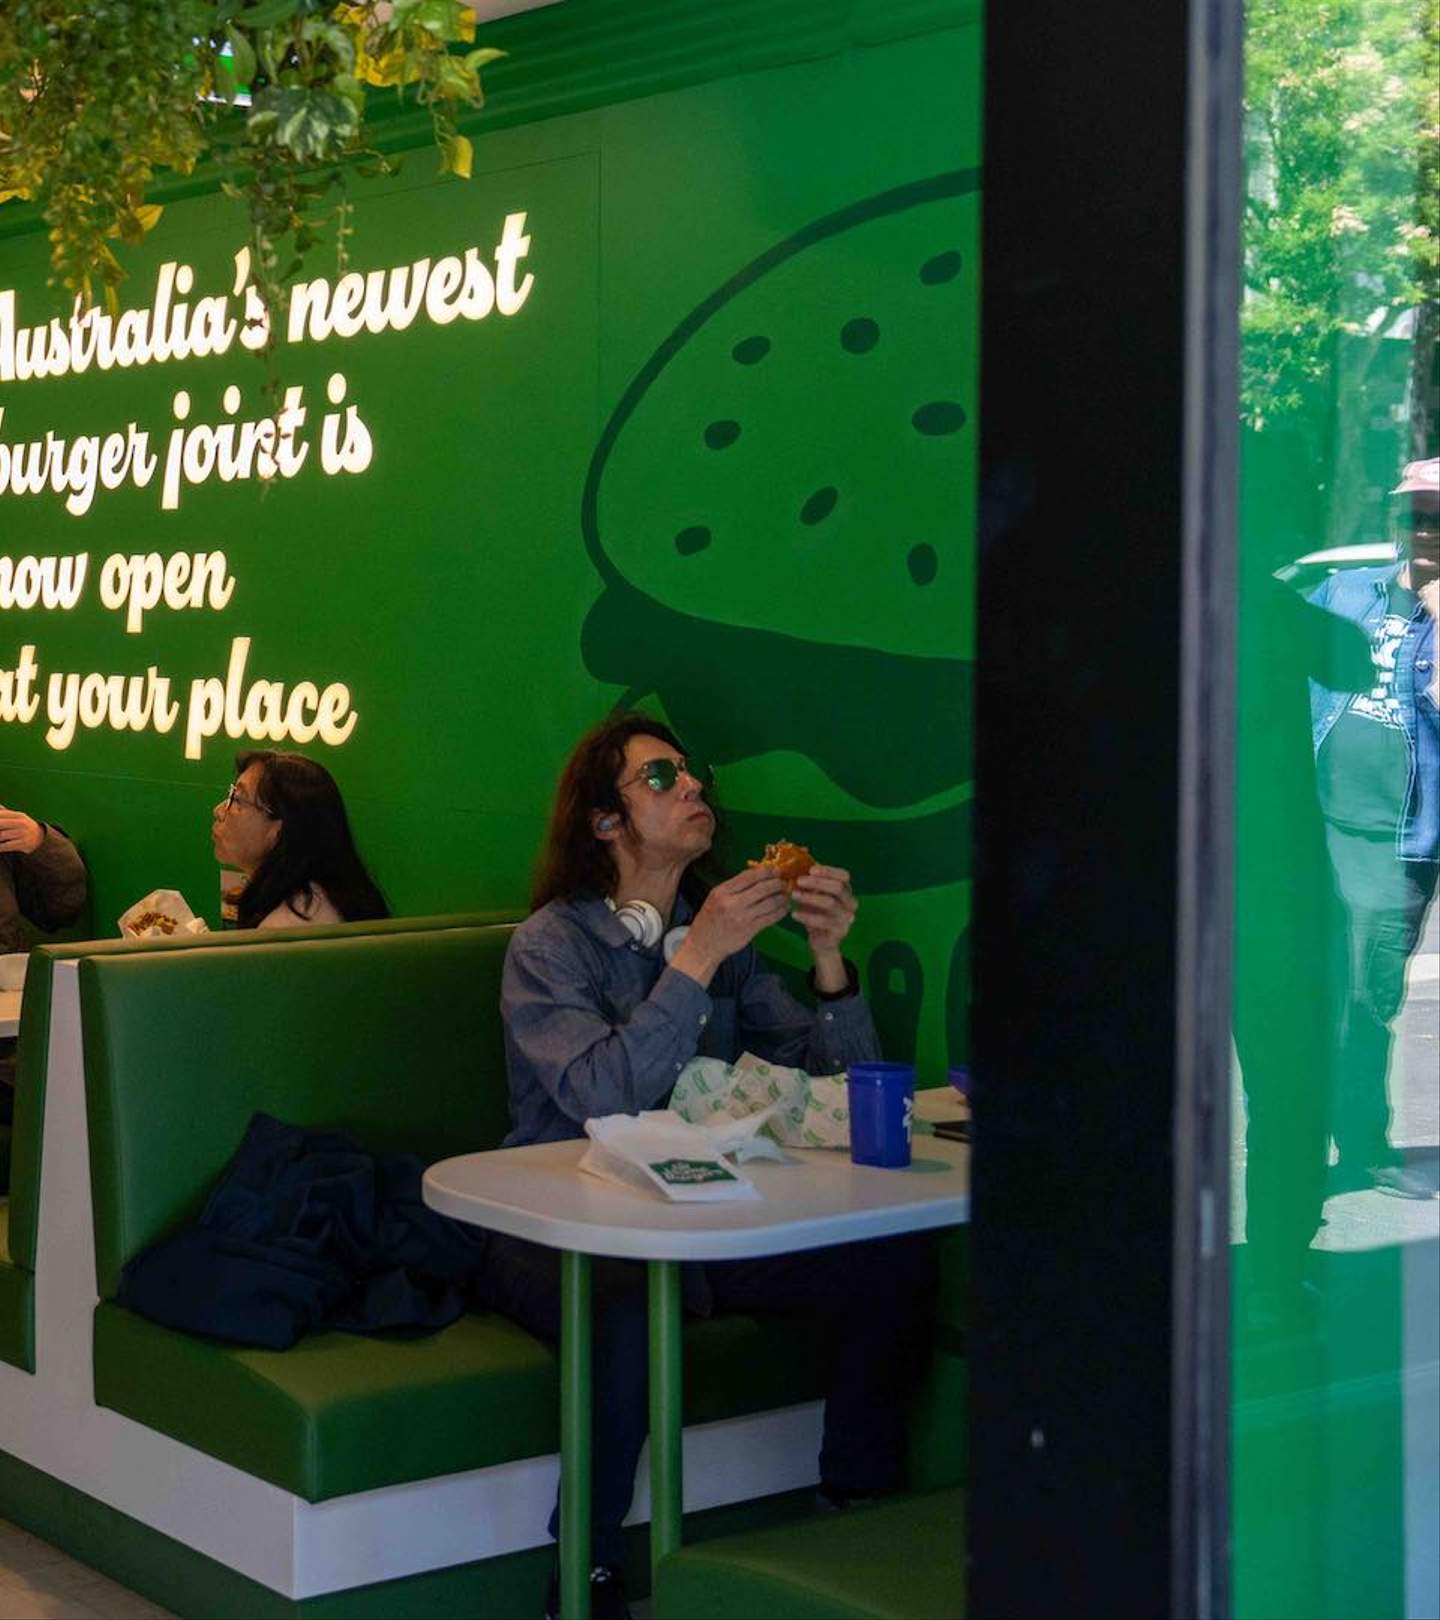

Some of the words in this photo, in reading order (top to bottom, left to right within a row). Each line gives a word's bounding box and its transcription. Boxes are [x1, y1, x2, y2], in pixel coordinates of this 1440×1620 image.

[287, 212, 535, 342] newest
[161, 385, 310, 511] joint
[321, 372, 374, 475] is
[99, 549, 236, 633] open
[45, 666, 180, 750] your
[184, 636, 359, 761] place
